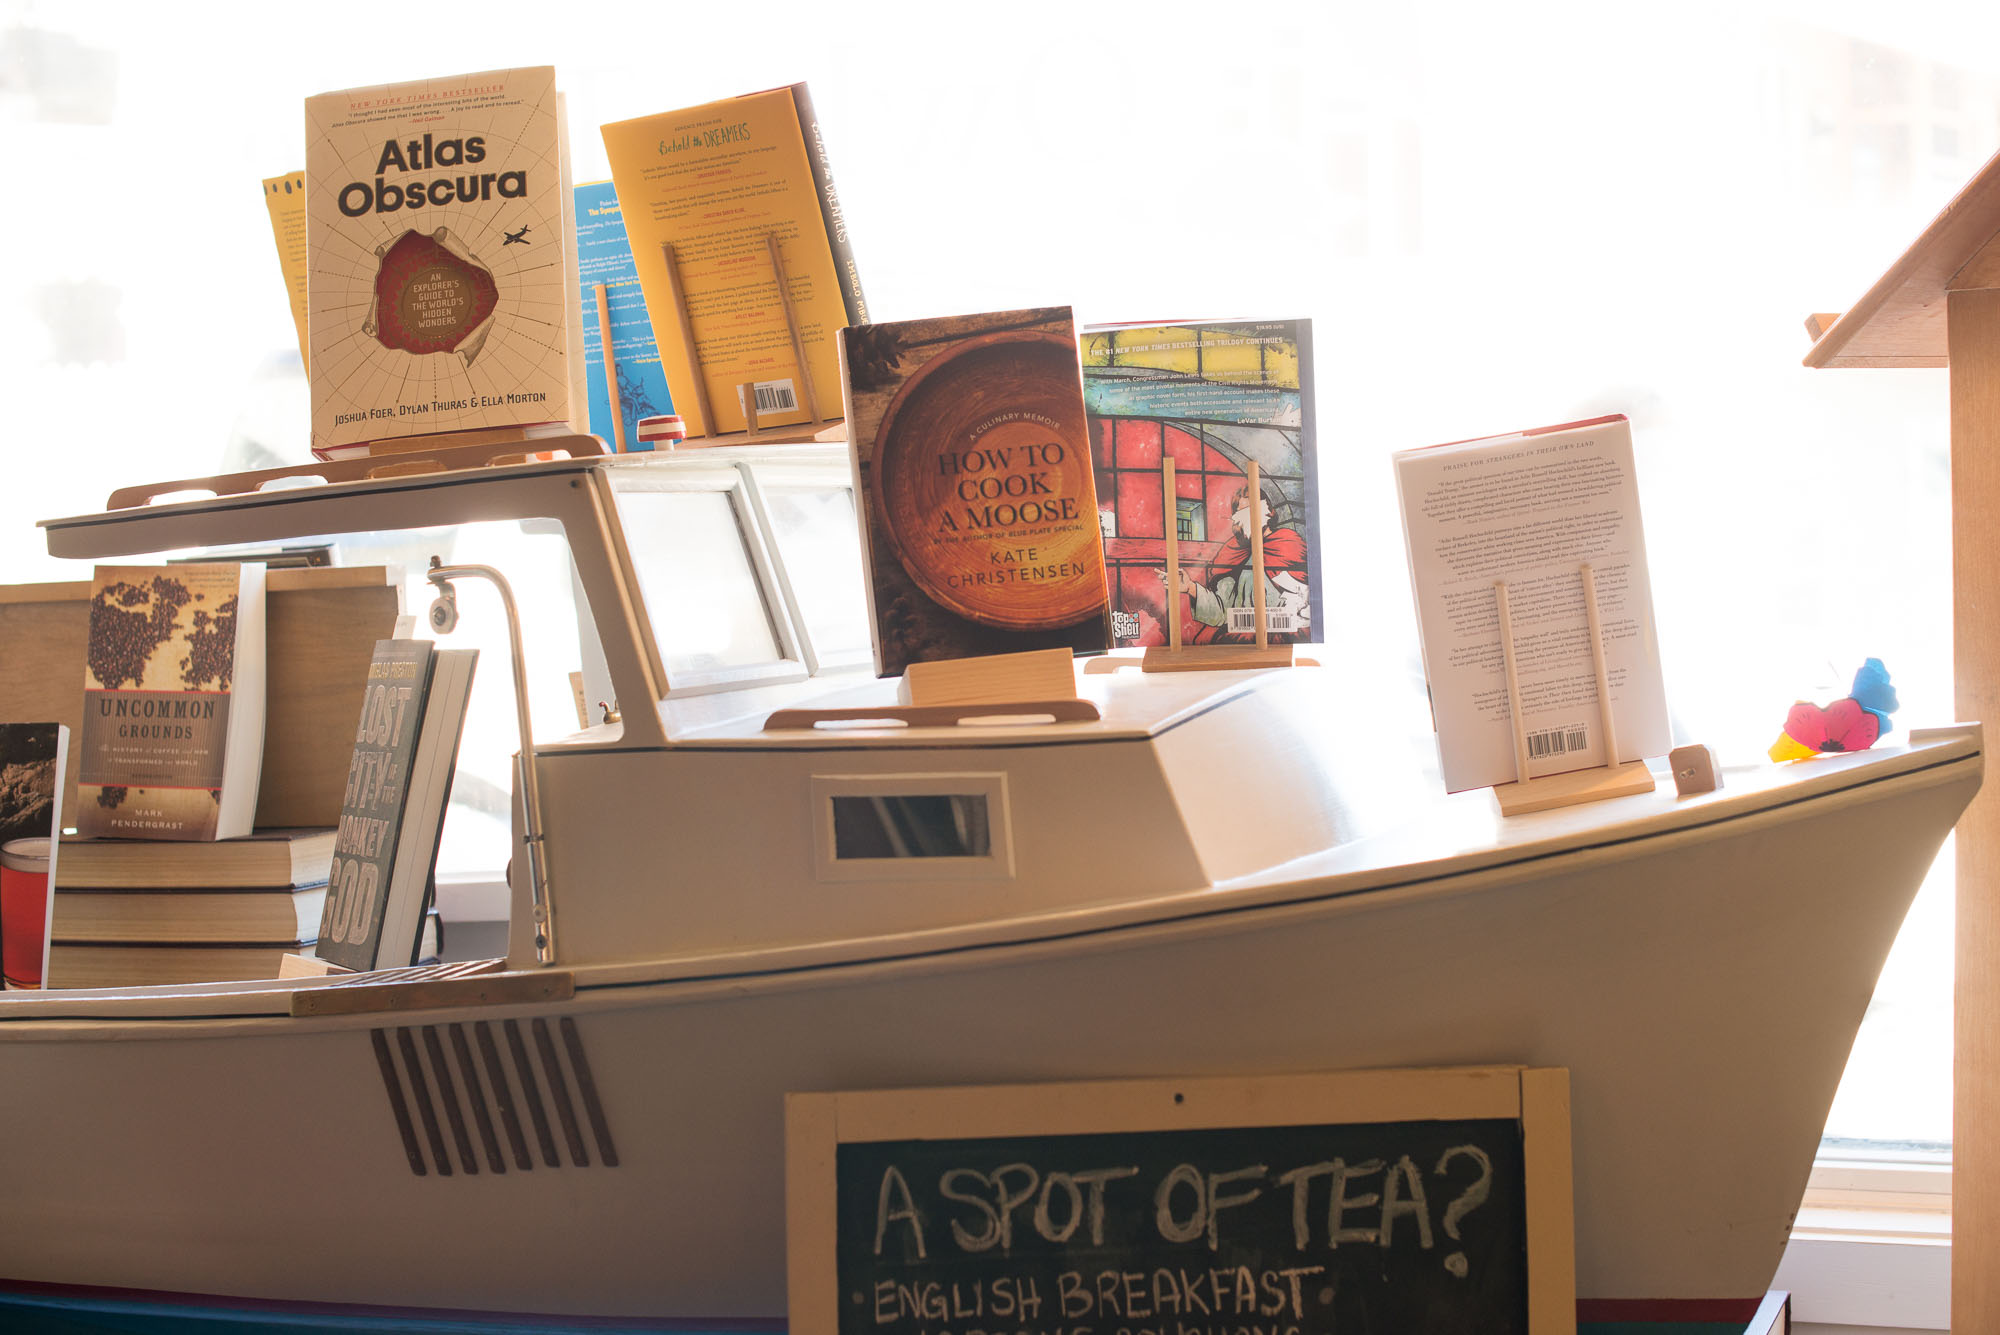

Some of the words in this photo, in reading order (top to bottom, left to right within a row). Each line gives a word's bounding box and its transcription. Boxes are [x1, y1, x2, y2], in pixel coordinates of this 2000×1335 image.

[408, 93, 438, 101] TIMES
[443, 85, 504, 97] BESTSELLER
[659, 134, 690, 155] Behold
[703, 122, 750, 148] DREAMERS
[375, 133, 486, 175] Atlas
[338, 170, 527, 218] Obscura
[825, 184, 848, 243] DREAMERS
[413, 280, 460, 292] EXPLORER'S
[431, 273, 441, 282] AN
[419, 291, 442, 301] GUIDE
[444, 290, 454, 298] TO
[847, 260, 861, 297] IMBOLO
[857, 300, 868, 326] MBUE
[412, 302, 427, 311] THE
[429, 297, 464, 309] WORLD'S
[422, 308, 452, 319] HIDDEN
[418, 317, 456, 328] WONDERS
[1172, 340, 1215, 348] BESTSELLING
[335, 412, 367, 426] JOSHUA
[370, 408, 396, 420] FOER,
[399, 404, 429, 416] DYLAN
[432, 400, 468, 412] THURAS
[470, 397, 478, 408] &
[482, 396, 504, 407] ELLA
[507, 392, 546, 404] MORTON
[977, 412, 1019, 434] CULINARY
[1023, 412, 1060, 430] MEMOIR
[938, 448, 1012, 476] HOW
[1020, 442, 1064, 467] TO
[1443, 462, 1467, 471] PRAISE
[1486, 452, 1524, 464] STRANGERS
[1536, 446, 1557, 455] THEIR
[958, 472, 1052, 502] COOK
[938, 510, 959, 532] A
[967, 497, 1078, 530] MOOSE
[962, 534, 993, 542] AUTHOR
[990, 548, 1038, 564] KATE
[947, 562, 1085, 589] CHRISTENSEN
[1115, 622, 1139, 638] Shelf
[100, 699, 215, 719] UNCOMMON
[356, 684, 412, 747] LOST
[120, 724, 192, 739] GROUNDS
[388, 764, 398, 781] OF
[381, 785, 395, 804] THE
[112, 820, 184, 829] PENDERGRAST
[873, 1164, 928, 1260] A
[939, 1162, 1140, 1258] SPOT
[1155, 1163, 1269, 1252] OF
[1275, 1143, 1493, 1279] TEA?
[874, 1276, 1042, 1325] ENGLISH
[1057, 1264, 1325, 1321] BREAKFAST
